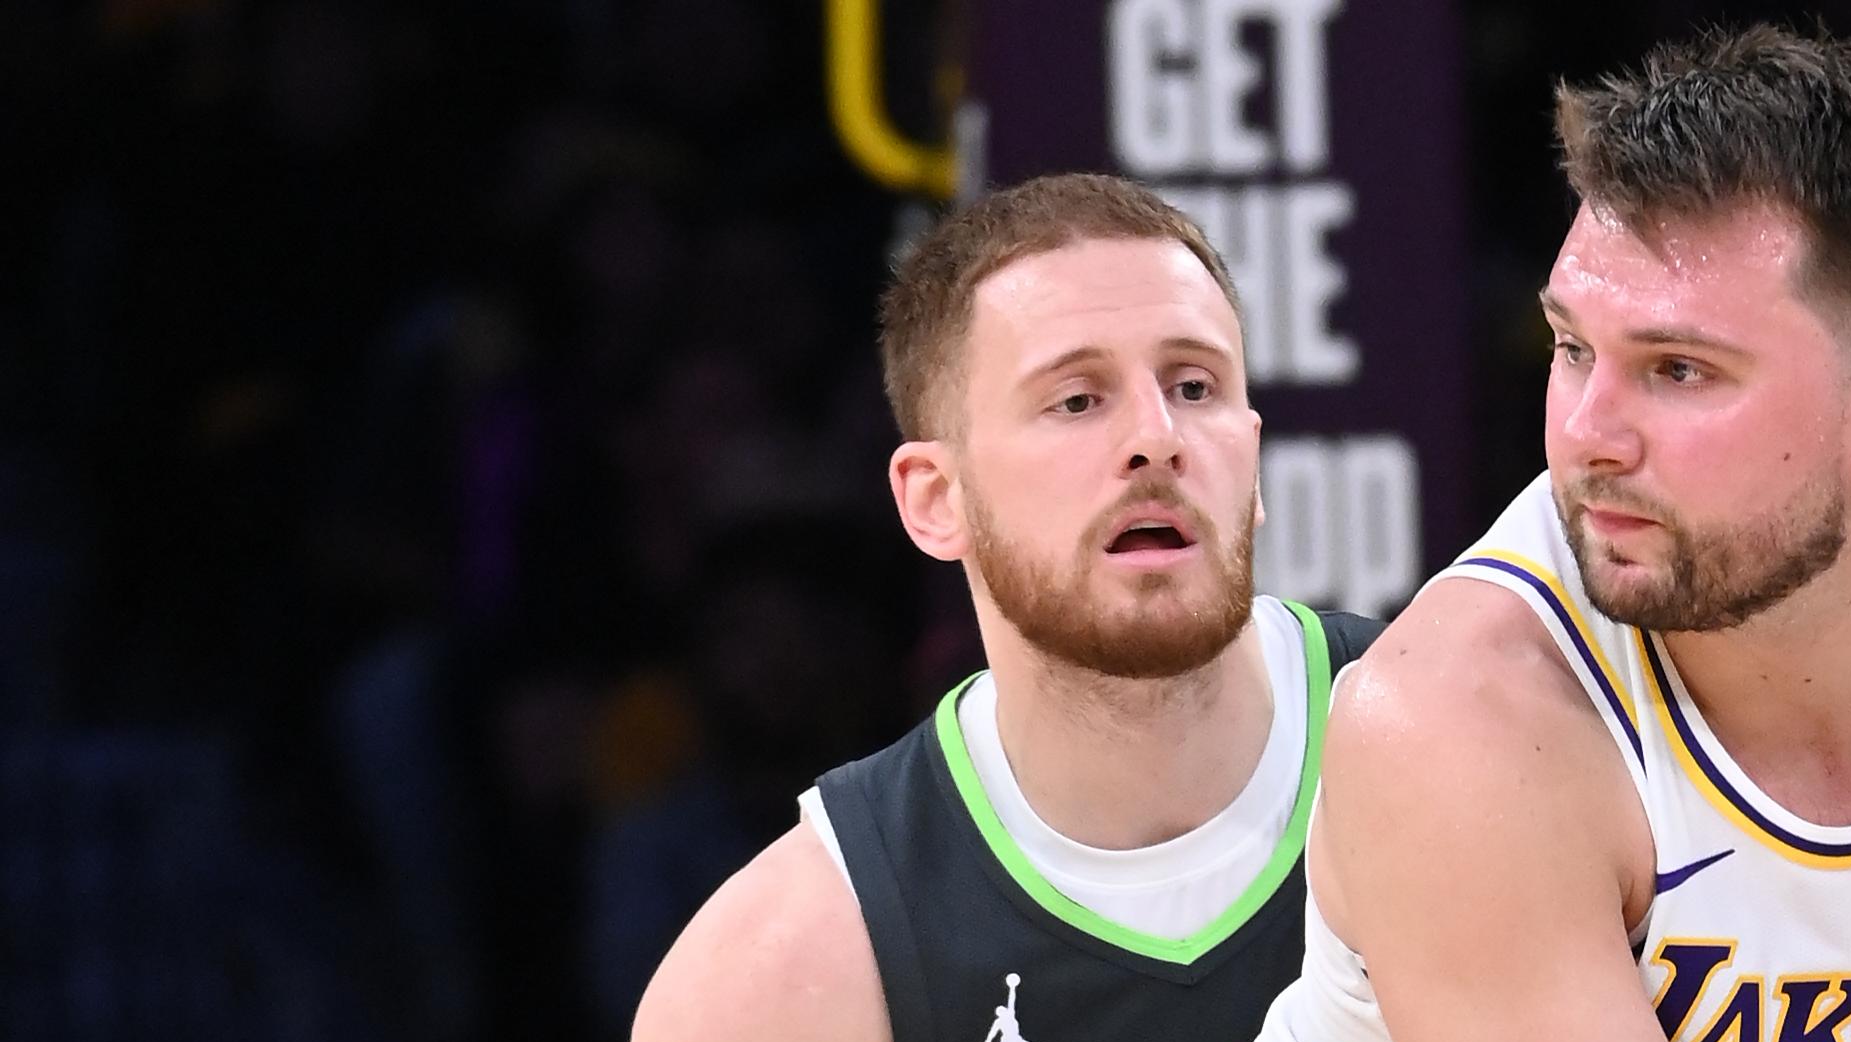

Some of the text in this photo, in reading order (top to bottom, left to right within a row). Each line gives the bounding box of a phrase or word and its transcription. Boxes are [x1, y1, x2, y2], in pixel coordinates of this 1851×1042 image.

[1109, 0, 1344, 176] GET
[1155, 183, 1362, 384] HE
[1252, 435, 1423, 618] PP
